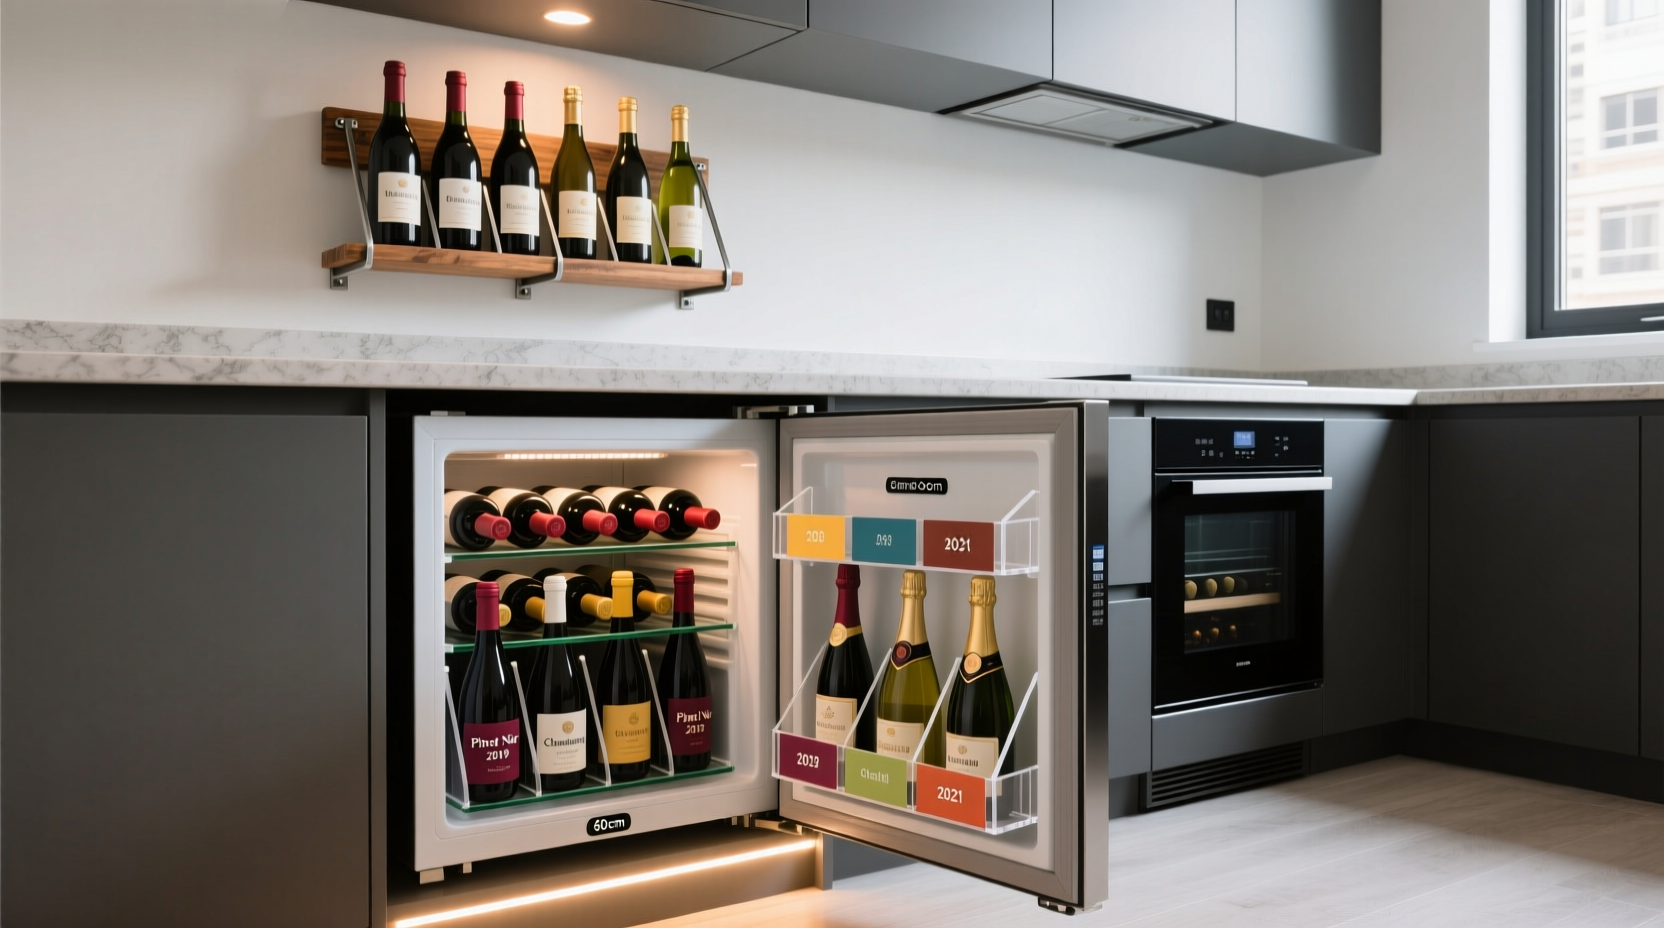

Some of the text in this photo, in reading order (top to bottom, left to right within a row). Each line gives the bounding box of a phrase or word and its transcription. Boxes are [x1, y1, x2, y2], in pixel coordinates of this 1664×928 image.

[944, 537, 971, 552] 2021
[486, 748, 510, 761] 2019
[937, 786, 963, 804] 2021
[593, 818, 625, 832] 60cm
